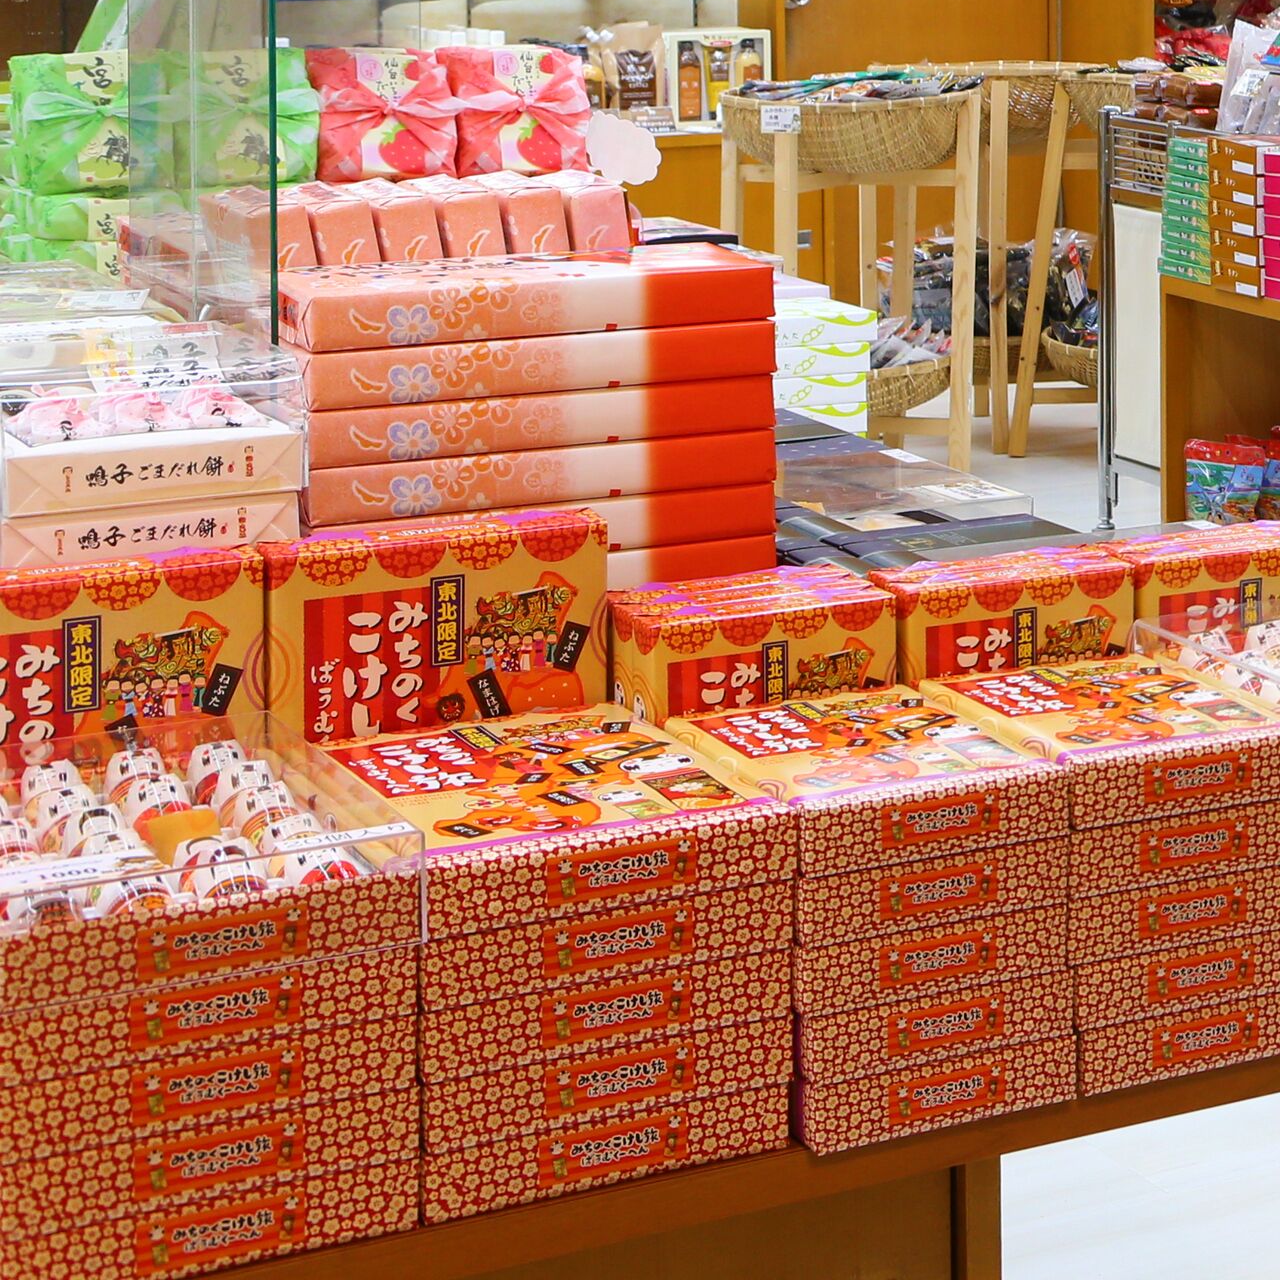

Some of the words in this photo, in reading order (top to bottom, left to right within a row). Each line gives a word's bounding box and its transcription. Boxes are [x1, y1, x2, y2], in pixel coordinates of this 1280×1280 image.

[86, 456, 223, 487] 鳴子ごまだれ餅
[78, 518, 216, 550] 鳴子ごまだれ餅
[437, 583, 457, 661] 東北限定
[559, 631, 579, 664] ねぶた
[70, 624, 93, 708] 東北限定
[343, 612, 387, 737] こけし
[389, 601, 428, 722] みちのく
[209, 673, 231, 707] ねぶた
[311, 659, 341, 742] ばうむ
[478, 679, 500, 716] なまはげ
[906, 804, 978, 824] みちのくこけし旅
[579, 851, 669, 876] みちのくこけし旅
[905, 875, 976, 894] みちのくこけし旅
[174, 922, 276, 949] みちのくこけし旅
[576, 922, 666, 946] みちのくこけし旅
[904, 943, 975, 963] みちのくこけし旅
[167, 989, 270, 1016] みちのくこけし旅
[574, 992, 663, 1016] みちのくこけし旅
[912, 1008, 983, 1031] みちのくこけし旅
[168, 1063, 271, 1090] みちのくこけし旅
[577, 1059, 666, 1086] みちのくこけし旅
[912, 1077, 984, 1100] みちのくこけし旅
[170, 1136, 272, 1166] みちのくこけし旅
[571, 1129, 660, 1156] みちのくこけし旅
[172, 1211, 274, 1241] みちのくこけし旅
